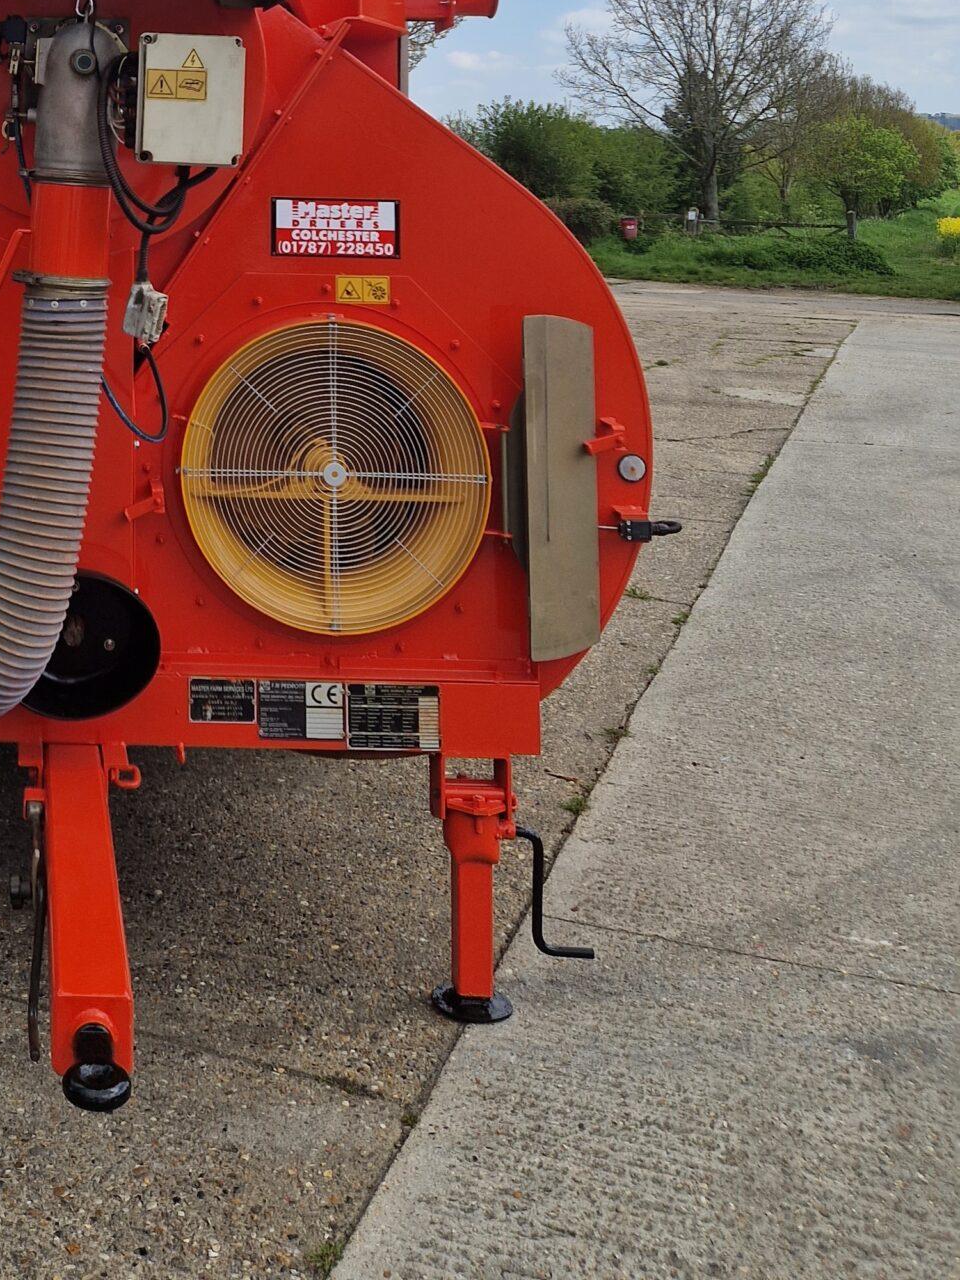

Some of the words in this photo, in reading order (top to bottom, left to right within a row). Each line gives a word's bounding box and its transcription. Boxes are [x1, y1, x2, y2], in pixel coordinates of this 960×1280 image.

[297, 201, 375, 220] Master
[292, 219, 380, 229] DRIERS
[291, 229, 380, 242] COLCHESTER
[277, 240, 331, 255] (01787)
[336, 242, 394, 256] 228450
[311, 684, 338, 705] CE
